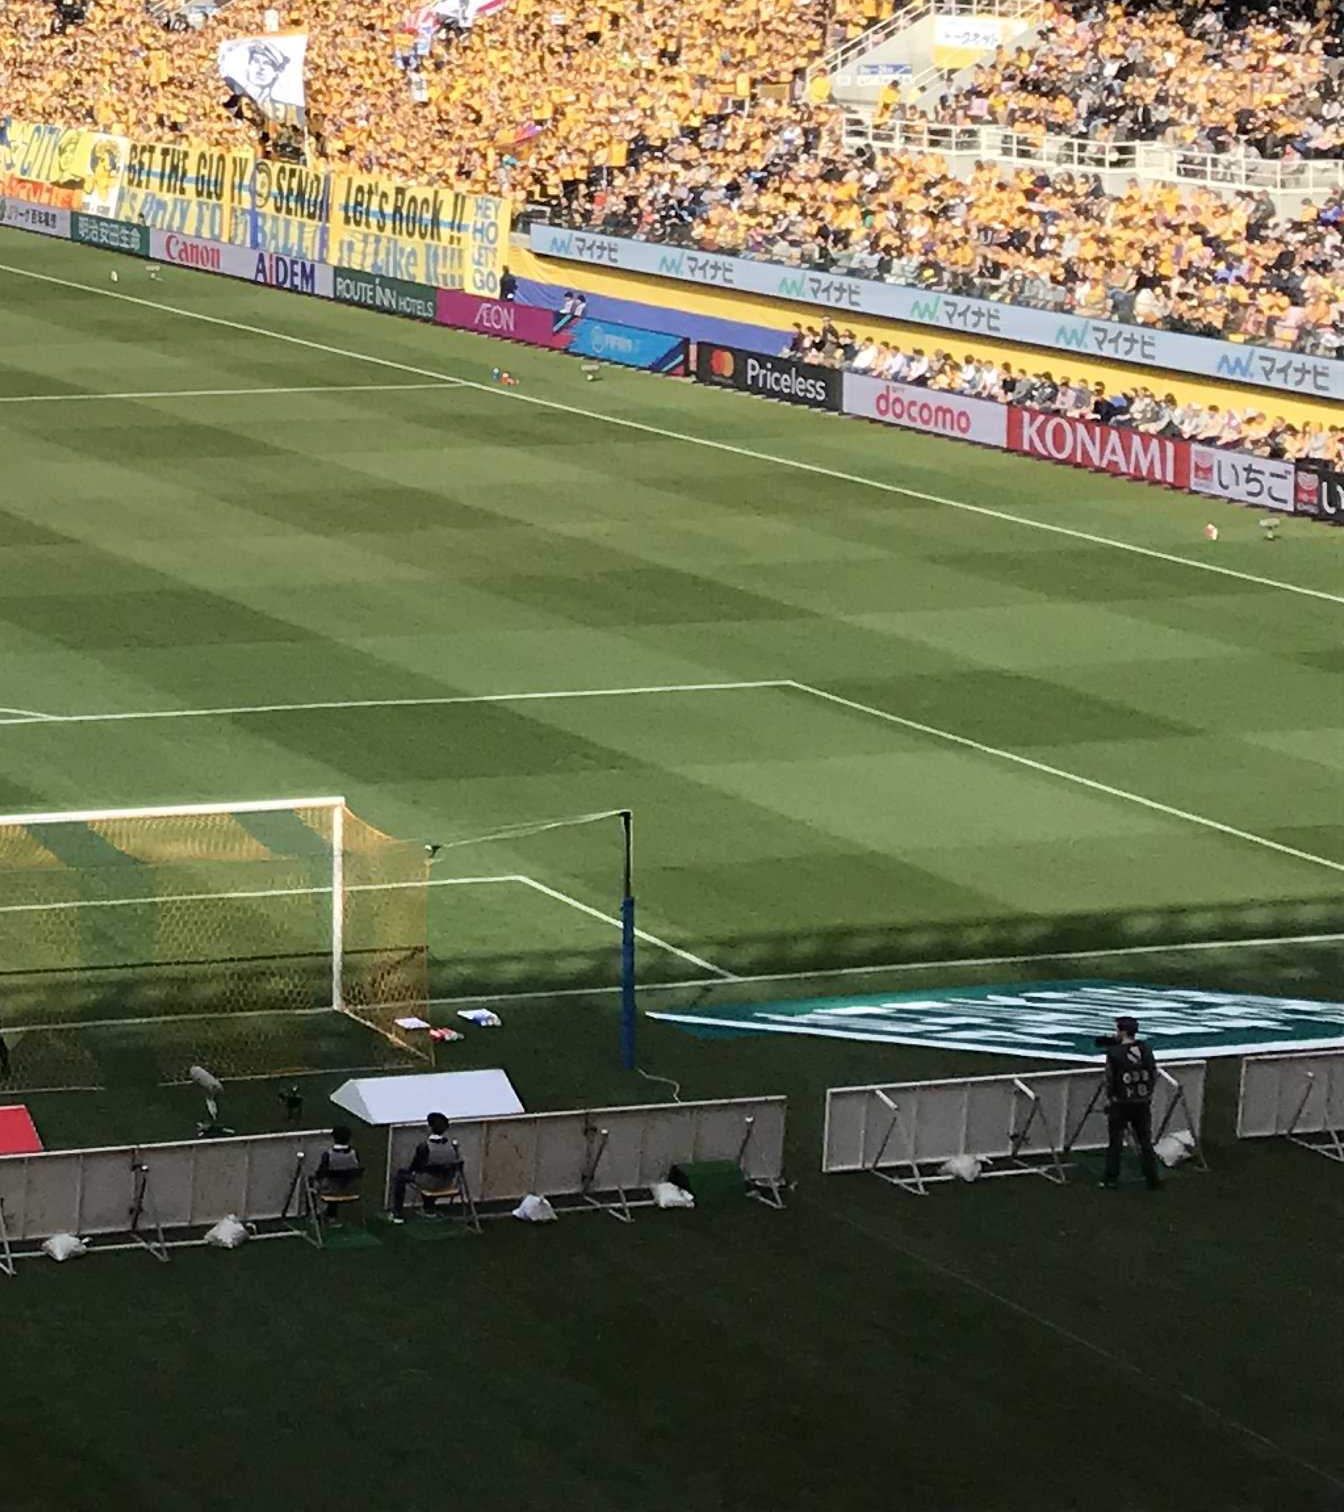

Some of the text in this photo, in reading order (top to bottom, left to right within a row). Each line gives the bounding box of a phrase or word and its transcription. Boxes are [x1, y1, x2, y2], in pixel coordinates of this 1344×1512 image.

[392, 184, 443, 243] Rock
[164, 234, 221, 271] Canon
[574, 237, 619, 264] マイナビ
[686, 255, 734, 285] マイナビ
[336, 277, 374, 305] ROUTE
[399, 296, 434, 319] HOTELS
[808, 276, 862, 307] マイナビ
[943, 300, 1001, 332] マイナビ
[1092, 325, 1157, 361] マイナビ
[746, 357, 827, 402] Priceless
[1259, 355, 1331, 391] マイナビ
[875, 385, 972, 433] docomo
[1021, 410, 1175, 483] KONAMI
[1216, 459, 1292, 505] いちご
